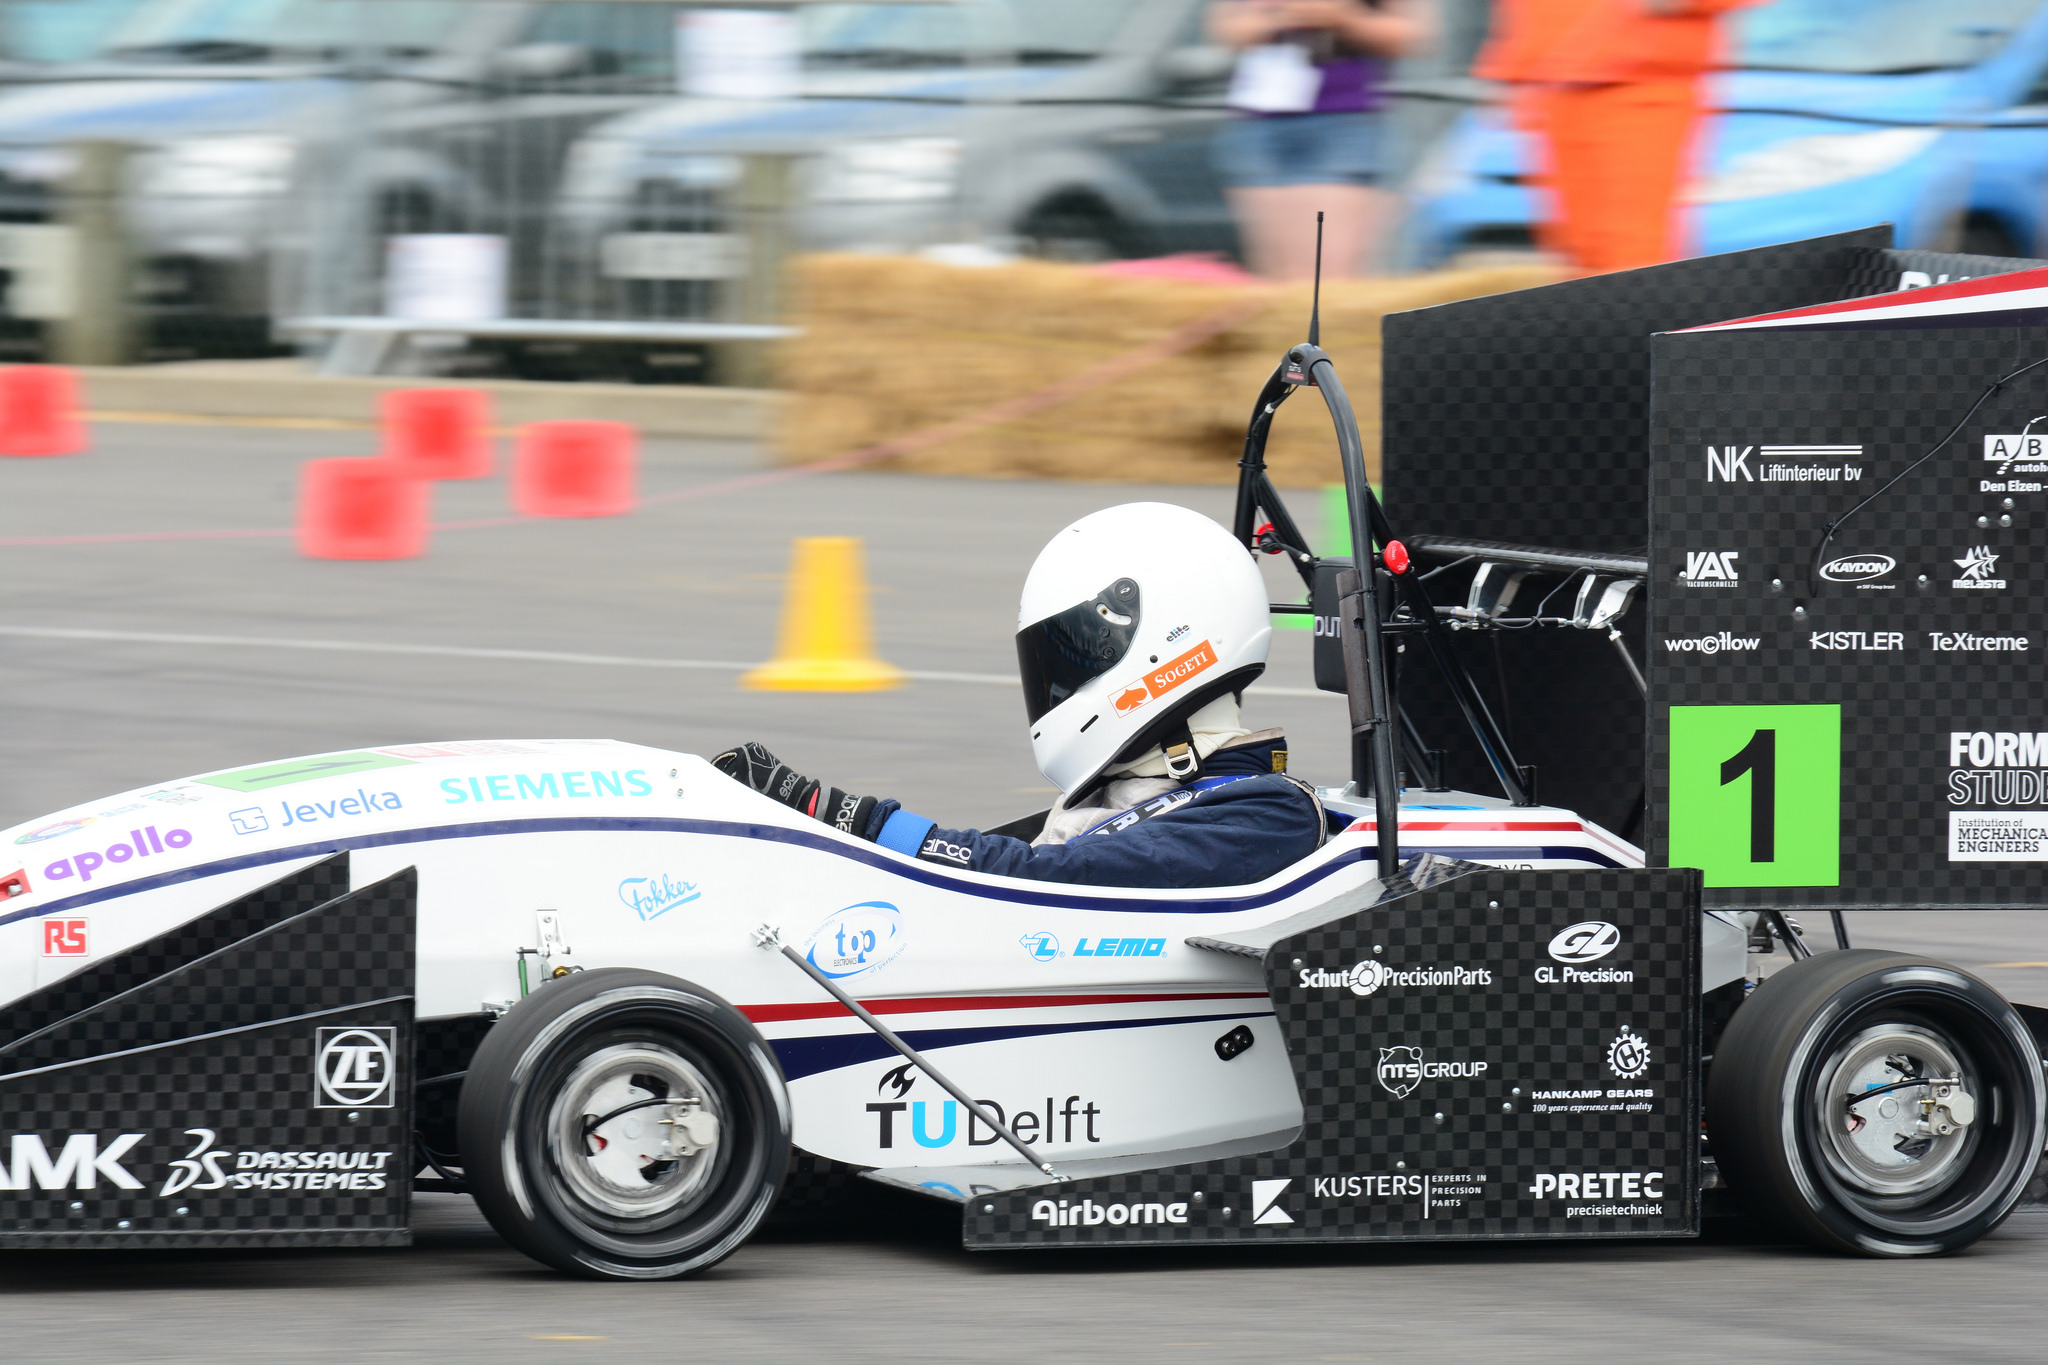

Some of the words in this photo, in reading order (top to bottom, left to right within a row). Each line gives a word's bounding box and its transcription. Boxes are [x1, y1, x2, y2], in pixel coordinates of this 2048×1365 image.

[1707, 446, 1754, 482] NK
[1760, 464, 1841, 482] Liftinterieur
[1844, 464, 1863, 481] bv
[2013, 462, 2048, 473] autoh
[1980, 480, 2006, 492] Den
[2007, 479, 2042, 492] Elzen
[1687, 551, 1739, 580] VAC
[1829, 562, 1888, 573] KAYDON
[1166, 625, 1190, 642] elite
[1809, 631, 1904, 651] KISTLER
[1928, 632, 2029, 651] TeXtreme
[1154, 650, 1209, 689] SOGETI
[439, 769, 653, 804] SIEMENS
[1720, 729, 1776, 863] 1
[281, 788, 403, 827] Jeveka
[1958, 818, 2012, 827] Institution
[2013, 818, 2024, 827] of
[44, 826, 193, 882] apollo
[1958, 841, 2040, 852] ENGINEERS
[618, 873, 701, 922] Fokker
[44, 920, 86, 953] RS
[835, 923, 876, 963] top
[1299, 967, 1350, 988] Schut
[1534, 967, 1559, 983] GL
[1563, 966, 1634, 983] Precision
[328, 1046, 384, 1089] ZF
[1423, 1061, 1488, 1078] GROUP
[1532, 1090, 1602, 1100] HANKAMP
[1606, 1088, 1654, 1098] GEARS
[1532, 1104, 1547, 1112] 100
[1548, 1104, 1568, 1114] years
[1570, 1103, 1608, 1113] experience
[1610, 1102, 1624, 1111] and
[1625, 1102, 1653, 1112] quality
[866, 1099, 957, 1148] TU
[968, 1096, 1100, 1147] Delft
[236, 1151, 393, 1170] DASSAULT
[233, 1172, 387, 1190] SYSTEMES
[1314, 1175, 1422, 1198] KUSTERS
[1431, 1174, 1471, 1183] EXPERTS
[1476, 1174, 1487, 1182] IN
[1529, 1172, 1664, 1200] PRETEC
[1431, 1186, 1482, 1195] PRECISION
[1032, 1199, 1188, 1226] Airborne
[1431, 1199, 1461, 1208] PARTS
[1566, 1203, 1663, 1219] precisietechniek
